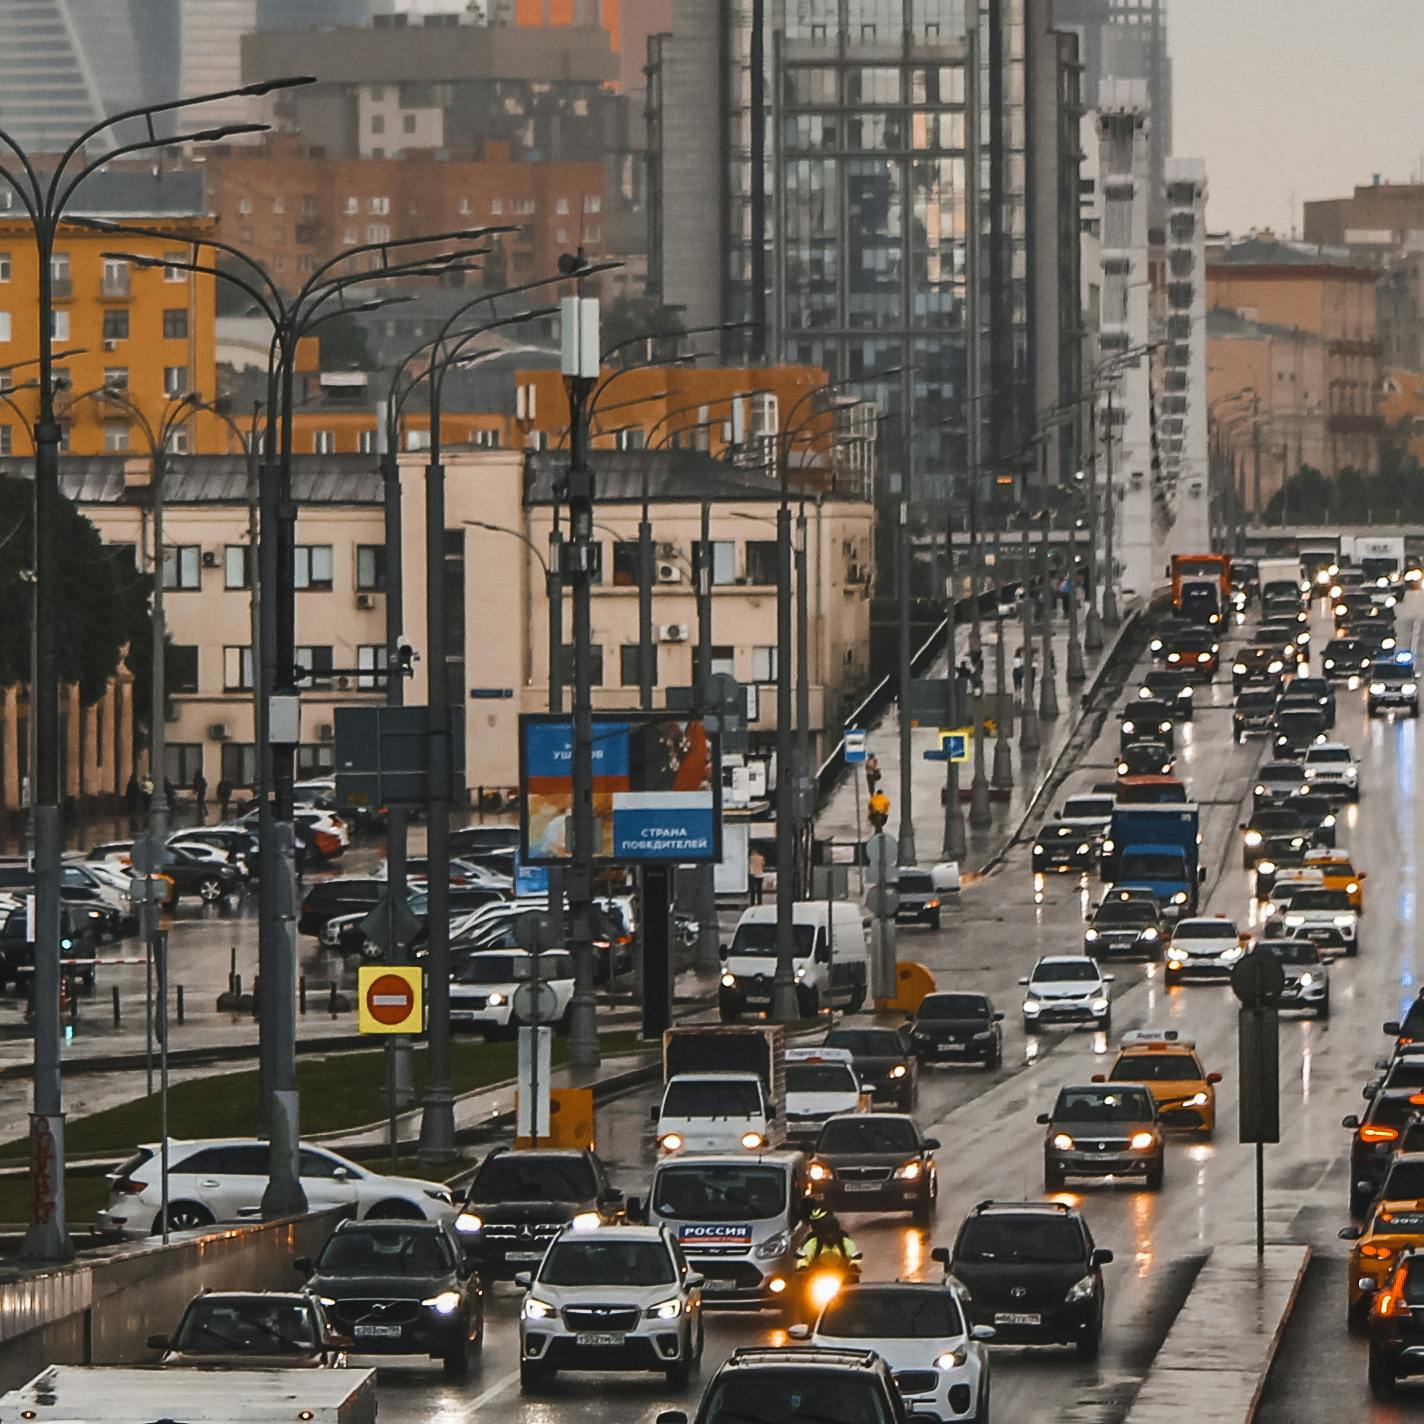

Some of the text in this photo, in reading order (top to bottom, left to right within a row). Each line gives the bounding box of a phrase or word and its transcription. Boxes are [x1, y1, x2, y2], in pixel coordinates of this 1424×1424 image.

[553, 750, 604, 760] УШОВ
[640, 828, 688, 838] СТРАНА
[622, 838, 708, 850] ПОБЕДИТЕЛЕЙ
[684, 1227, 747, 1236] РОССИЯ
